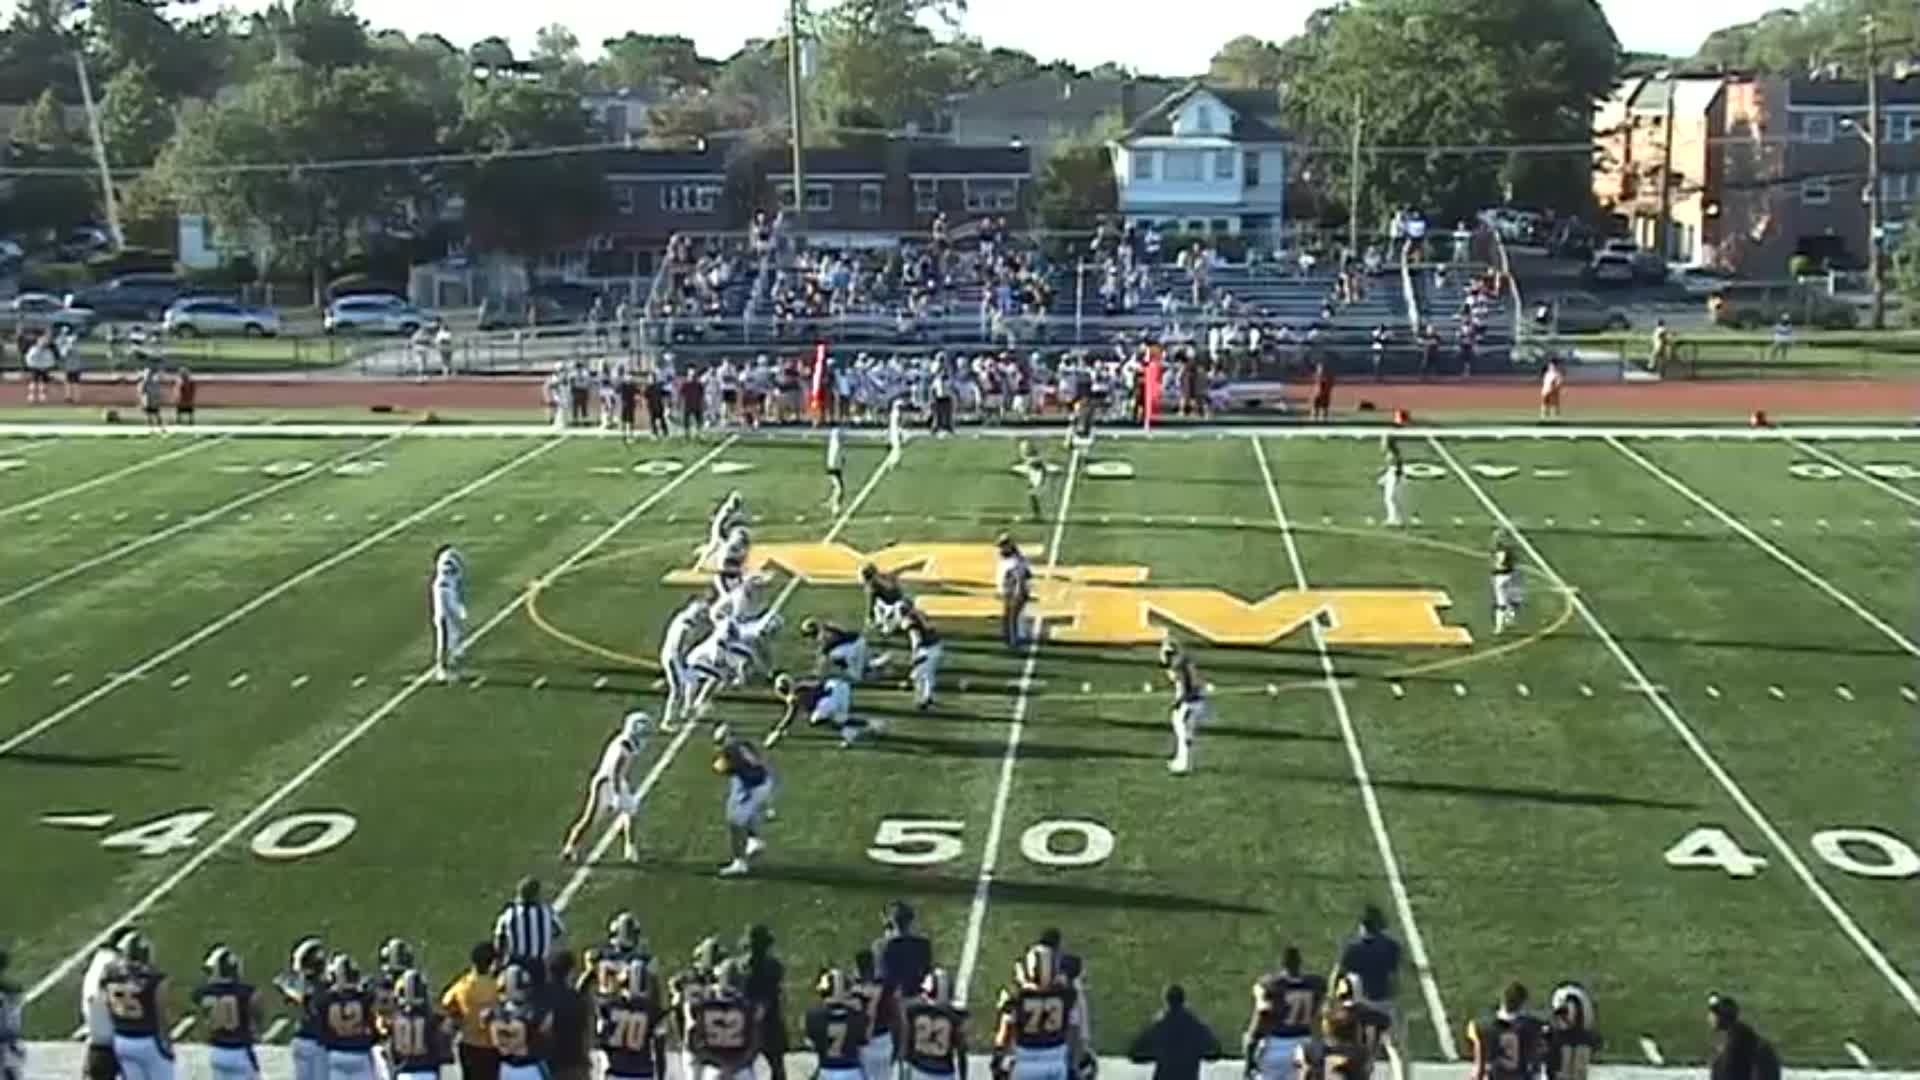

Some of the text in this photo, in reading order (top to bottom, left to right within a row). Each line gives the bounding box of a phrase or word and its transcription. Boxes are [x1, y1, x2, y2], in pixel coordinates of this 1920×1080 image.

[101, 808, 357, 857] 40
[866, 820, 1116, 866] 50
[1664, 827, 1920, 876] 40
[609, 1009, 649, 1051] 70
[703, 1009, 746, 1047] 52
[914, 1014, 952, 1057] 23
[1022, 997, 1063, 1034] 73
[828, 1023, 848, 1057] 7
